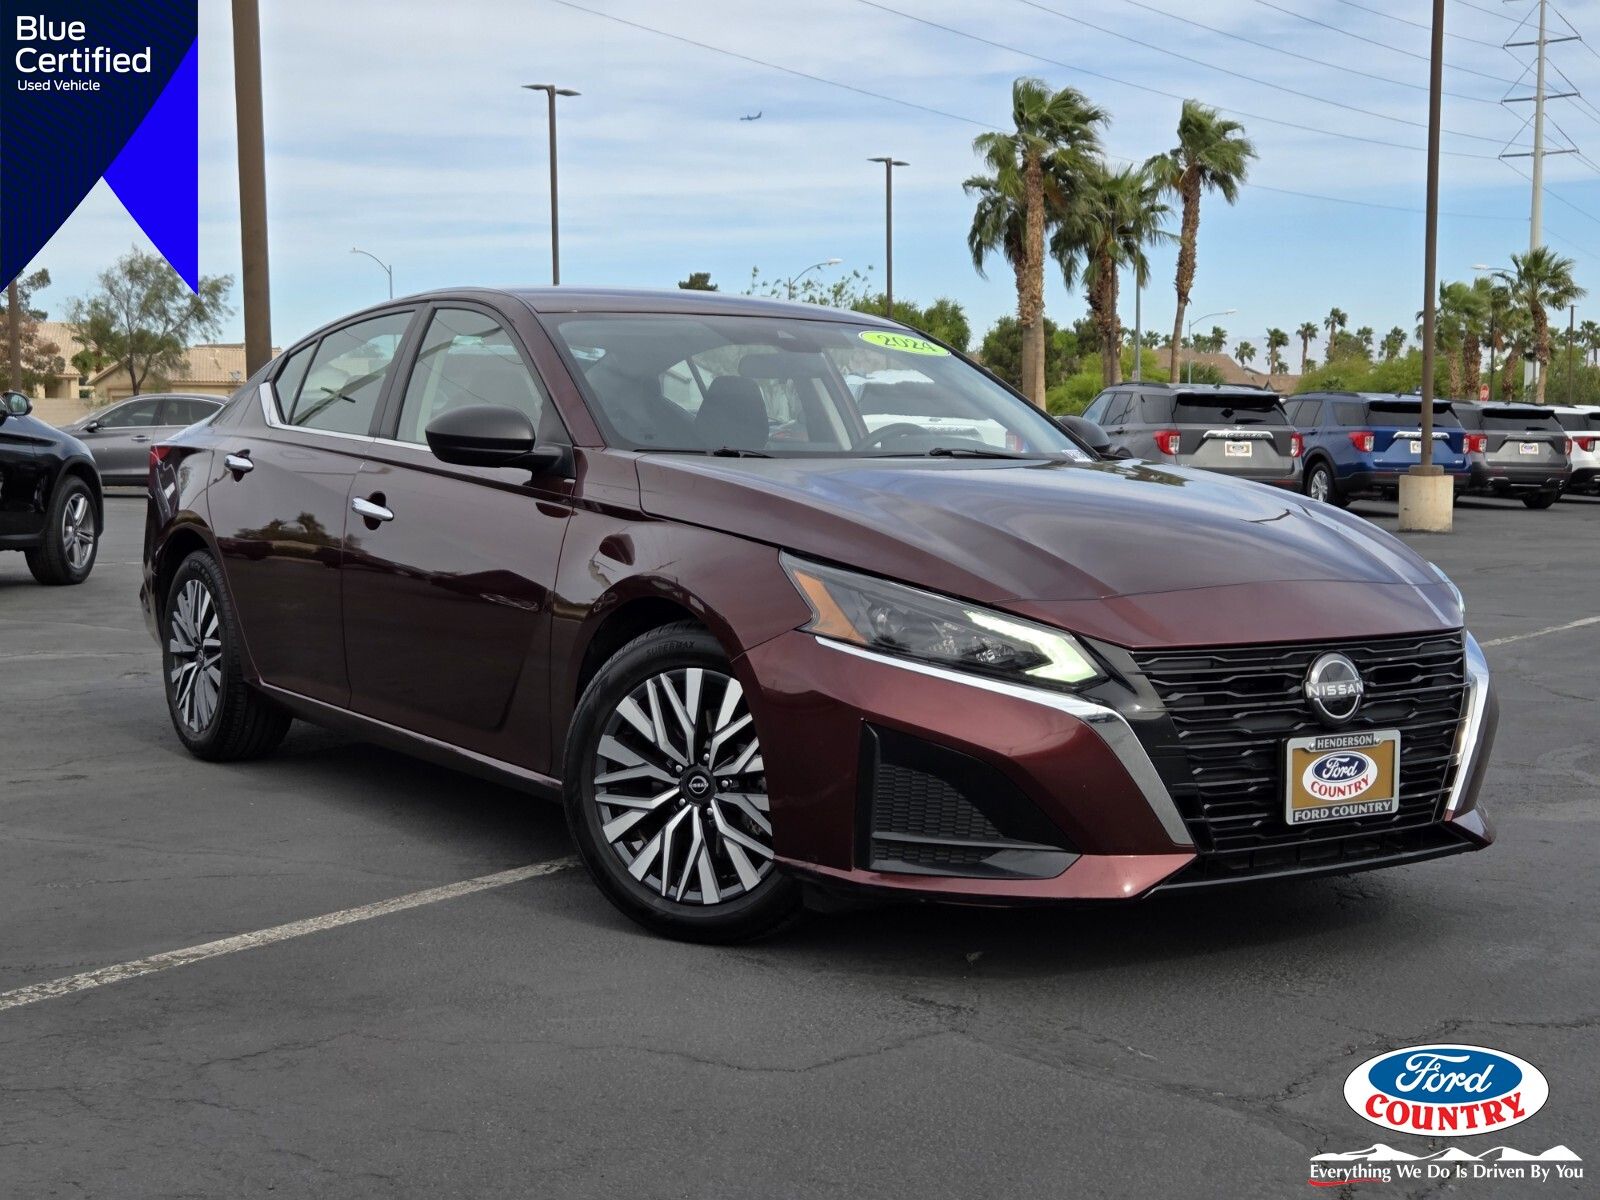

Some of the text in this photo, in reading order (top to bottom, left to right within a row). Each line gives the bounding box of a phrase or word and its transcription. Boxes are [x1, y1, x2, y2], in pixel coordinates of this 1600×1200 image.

[877, 334, 937, 352] 2024
[1307, 681, 1364, 697] NISSAN
[1317, 734, 1373, 749] HENDERSON
[1322, 756, 1360, 779] Ford
[1310, 774, 1370, 798] COUNTRY
[1294, 801, 1392, 822] FORD COUNTRY
